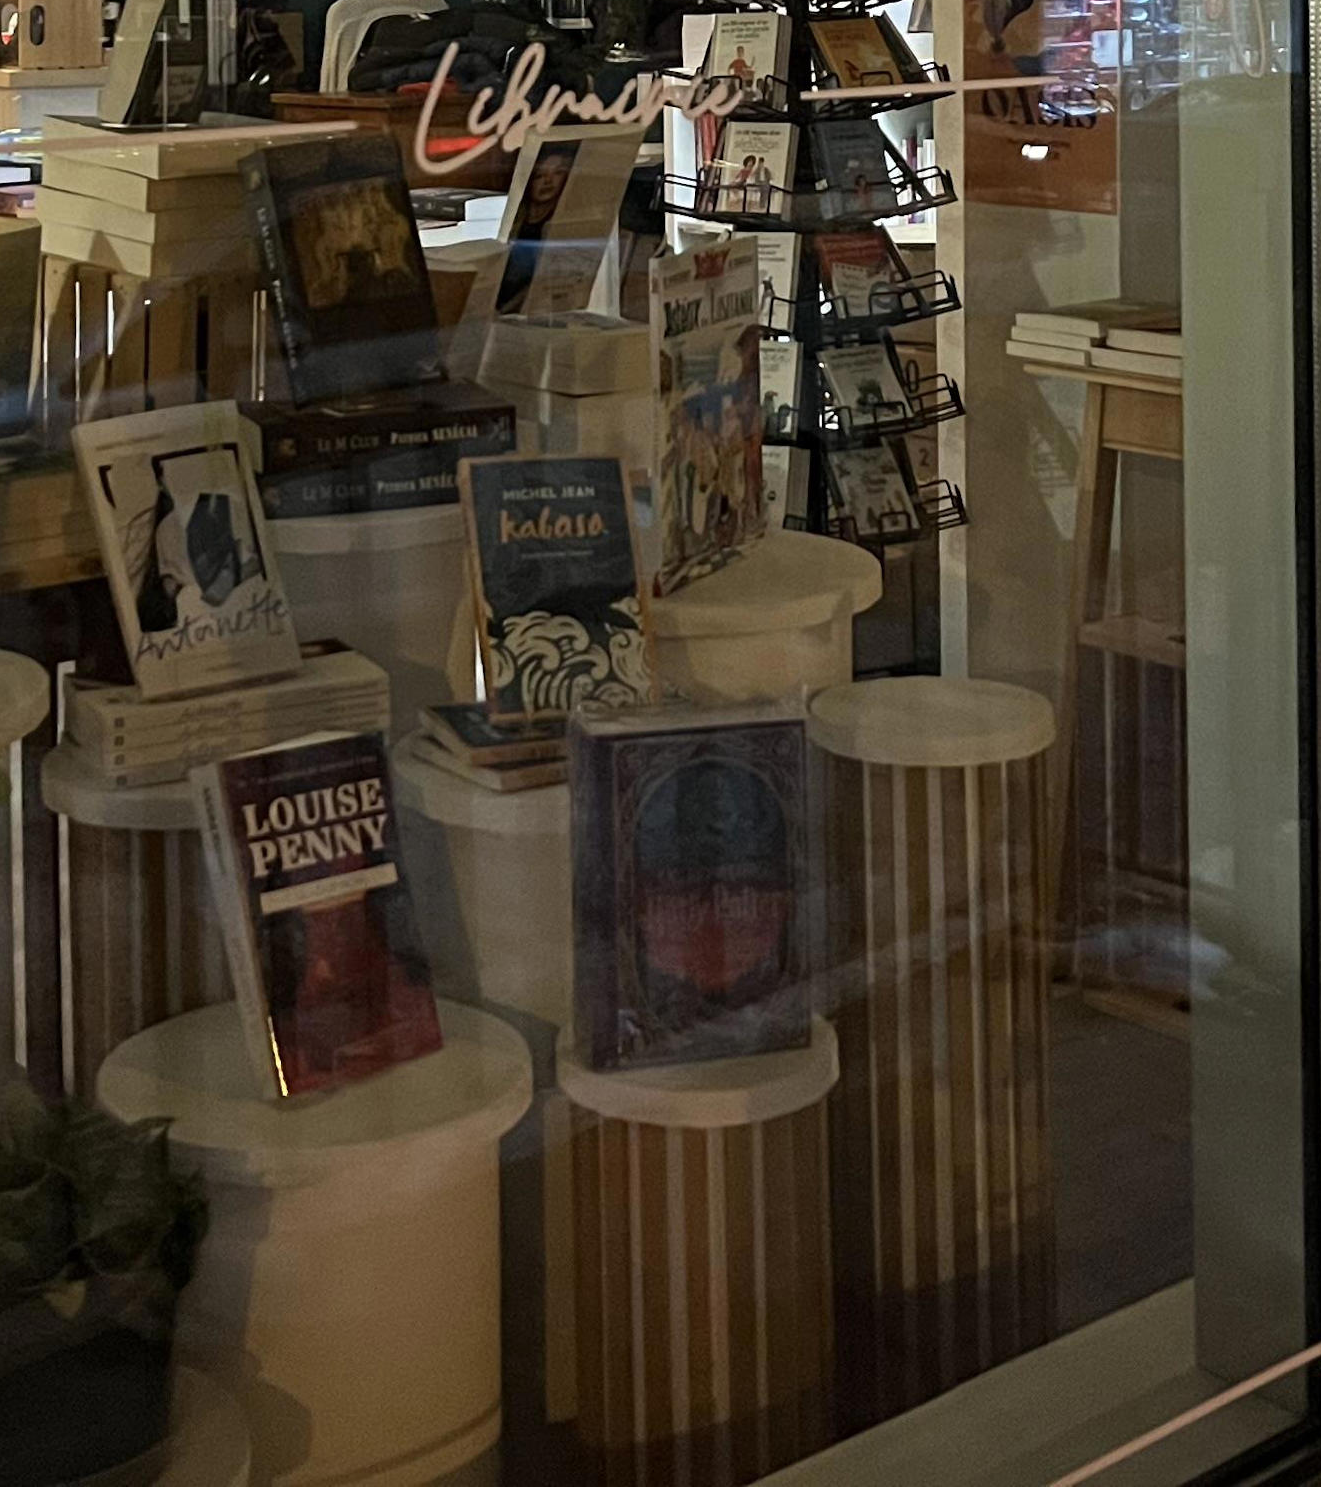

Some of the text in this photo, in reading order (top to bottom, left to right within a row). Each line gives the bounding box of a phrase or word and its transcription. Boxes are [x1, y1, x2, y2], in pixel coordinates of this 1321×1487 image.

[502, 485, 596, 501] MICHEL JEAN
[241, 776, 386, 839] LOUISE
[248, 813, 388, 878] PENNY
